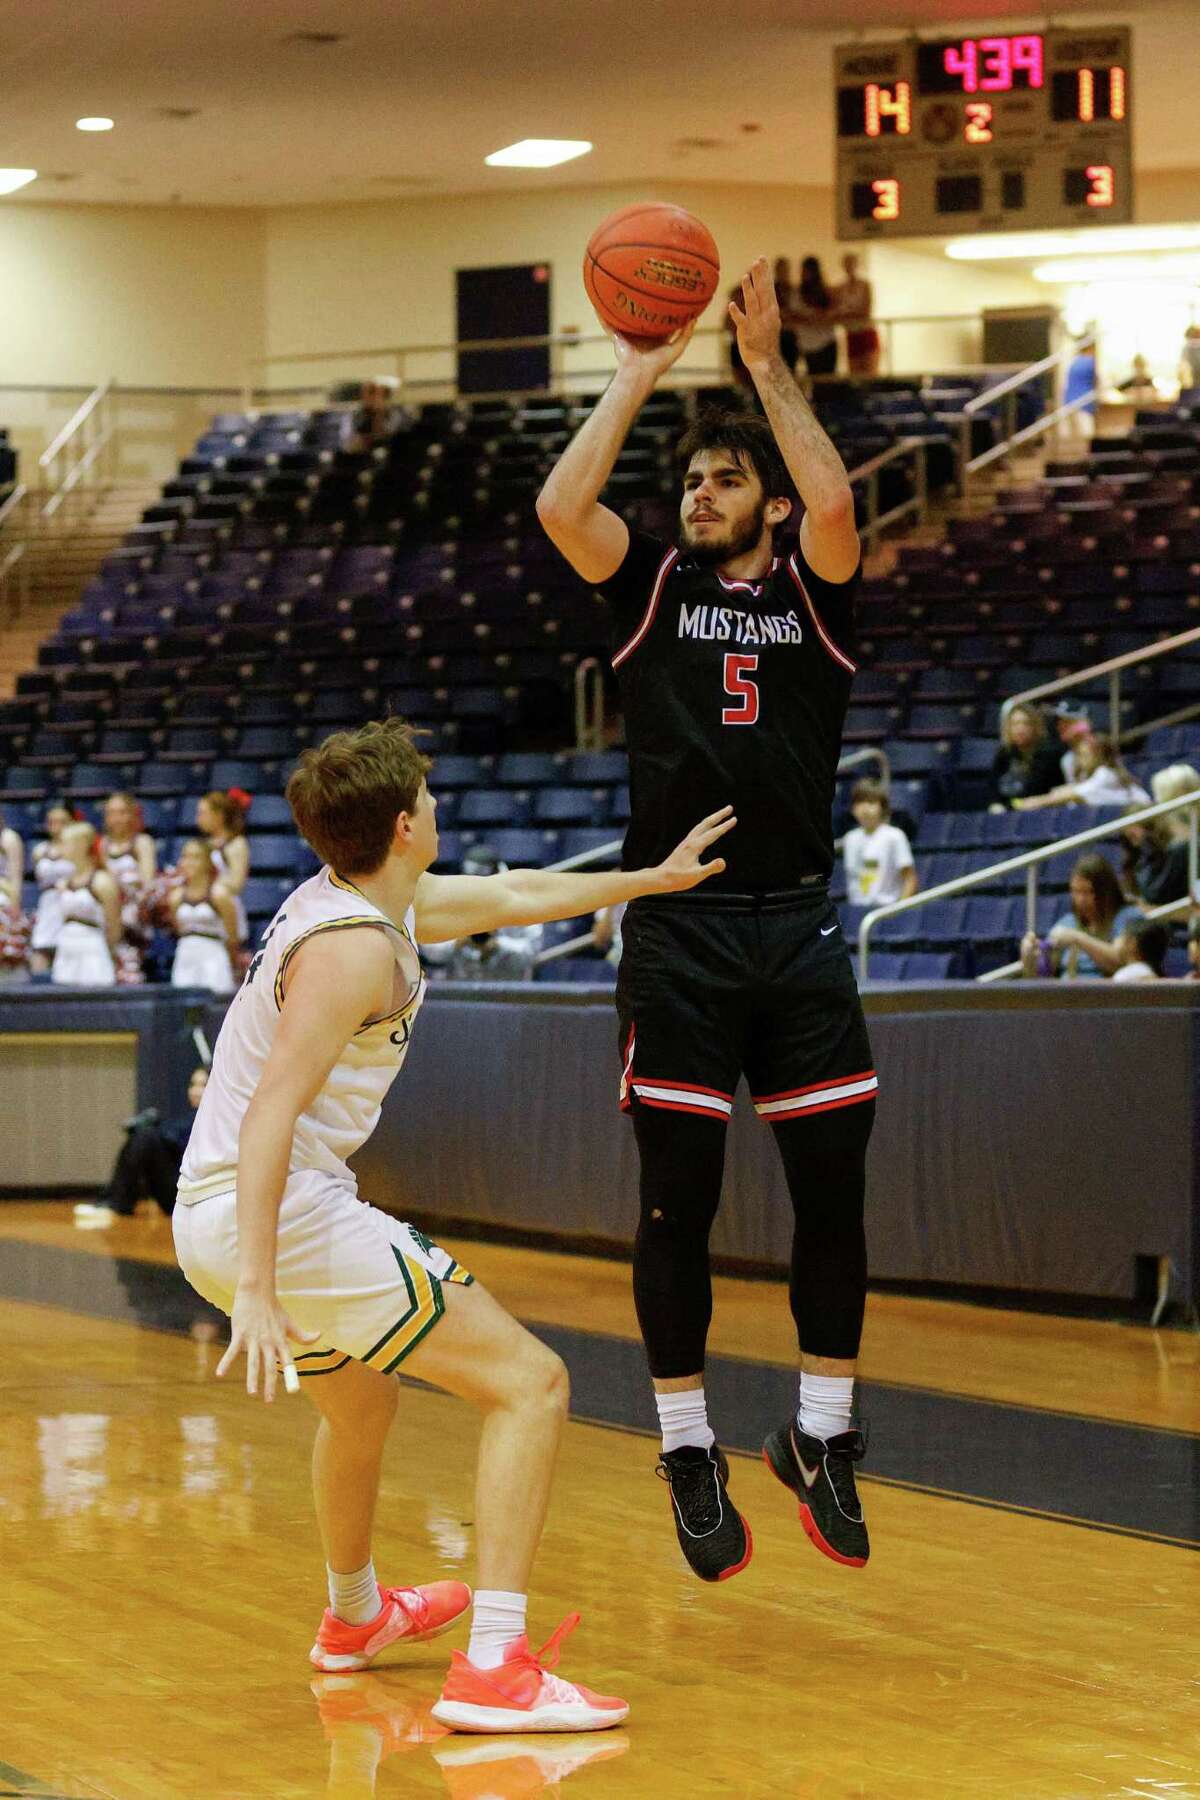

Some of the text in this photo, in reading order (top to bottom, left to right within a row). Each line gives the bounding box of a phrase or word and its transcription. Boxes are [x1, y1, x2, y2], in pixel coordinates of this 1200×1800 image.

[865, 81, 911, 137] 14
[1078, 66, 1125, 122] 11
[964, 102, 993, 143] 2
[872, 179, 899, 220] 3
[1085, 165, 1114, 207] 3
[677, 603, 803, 645] MUSTANGS
[722, 653, 760, 725] 5
